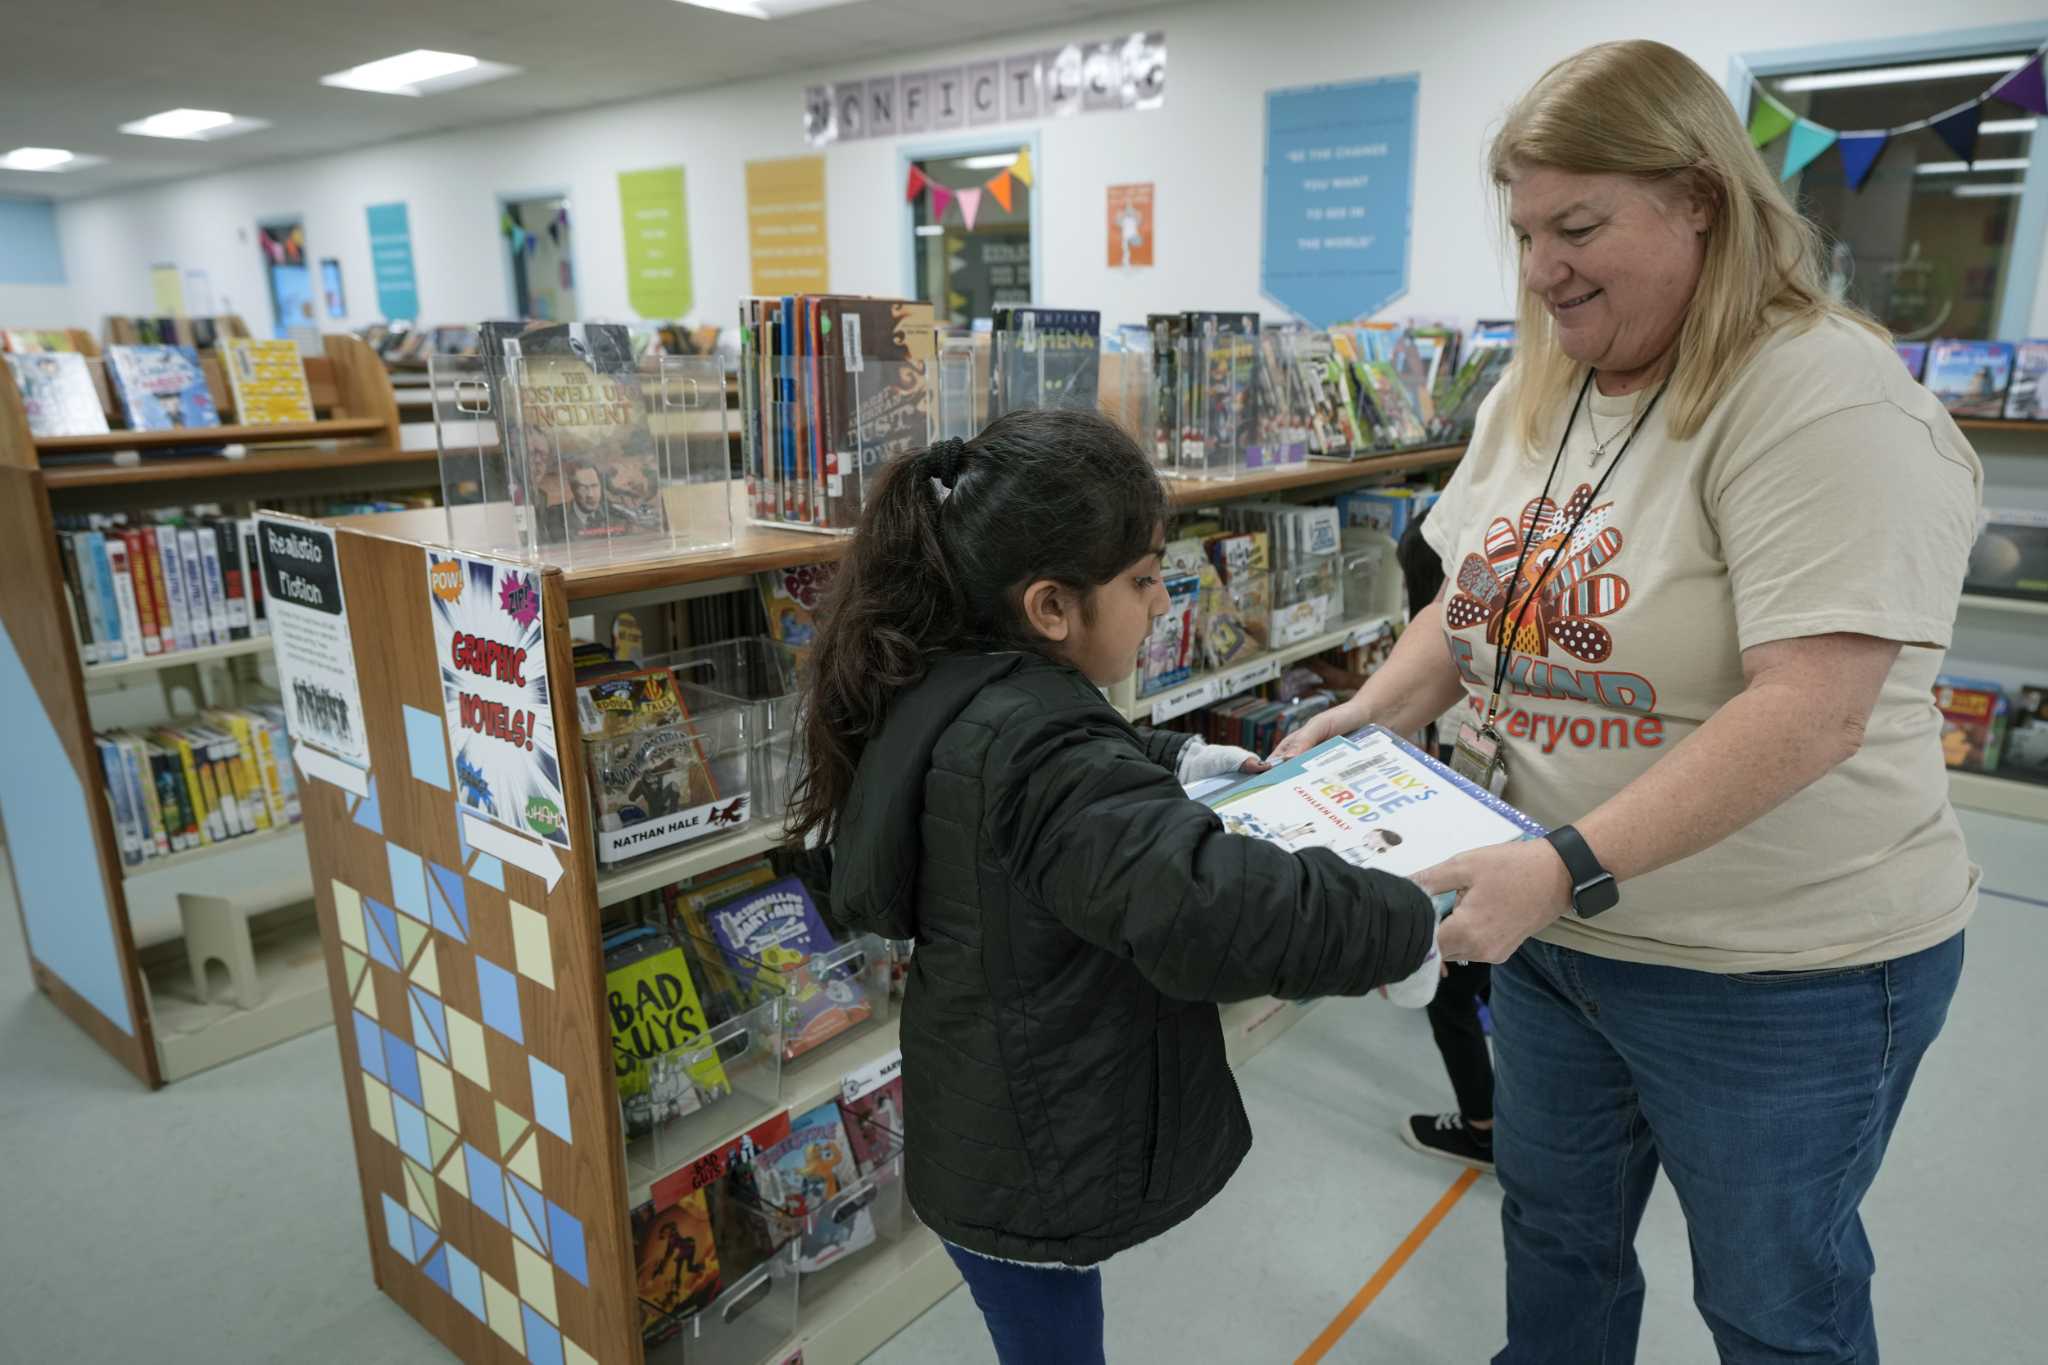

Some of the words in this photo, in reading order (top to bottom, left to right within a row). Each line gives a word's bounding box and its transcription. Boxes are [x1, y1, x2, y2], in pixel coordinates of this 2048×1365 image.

[267, 527, 322, 563] Realistic
[279, 570, 323, 604] Fiction
[431, 567, 463, 590] POW!
[508, 586, 529, 615] ZIP!
[451, 630, 526, 688] GRAPHIC
[458, 691, 536, 752] NOVELS!
[1348, 773, 1416, 814] LUE
[1376, 763, 1438, 801] MILY'S
[613, 826, 666, 849] NATHAN
[668, 815, 700, 833] HALE
[608, 972, 684, 1033] BAD
[612, 1005, 701, 1077] GUYS
